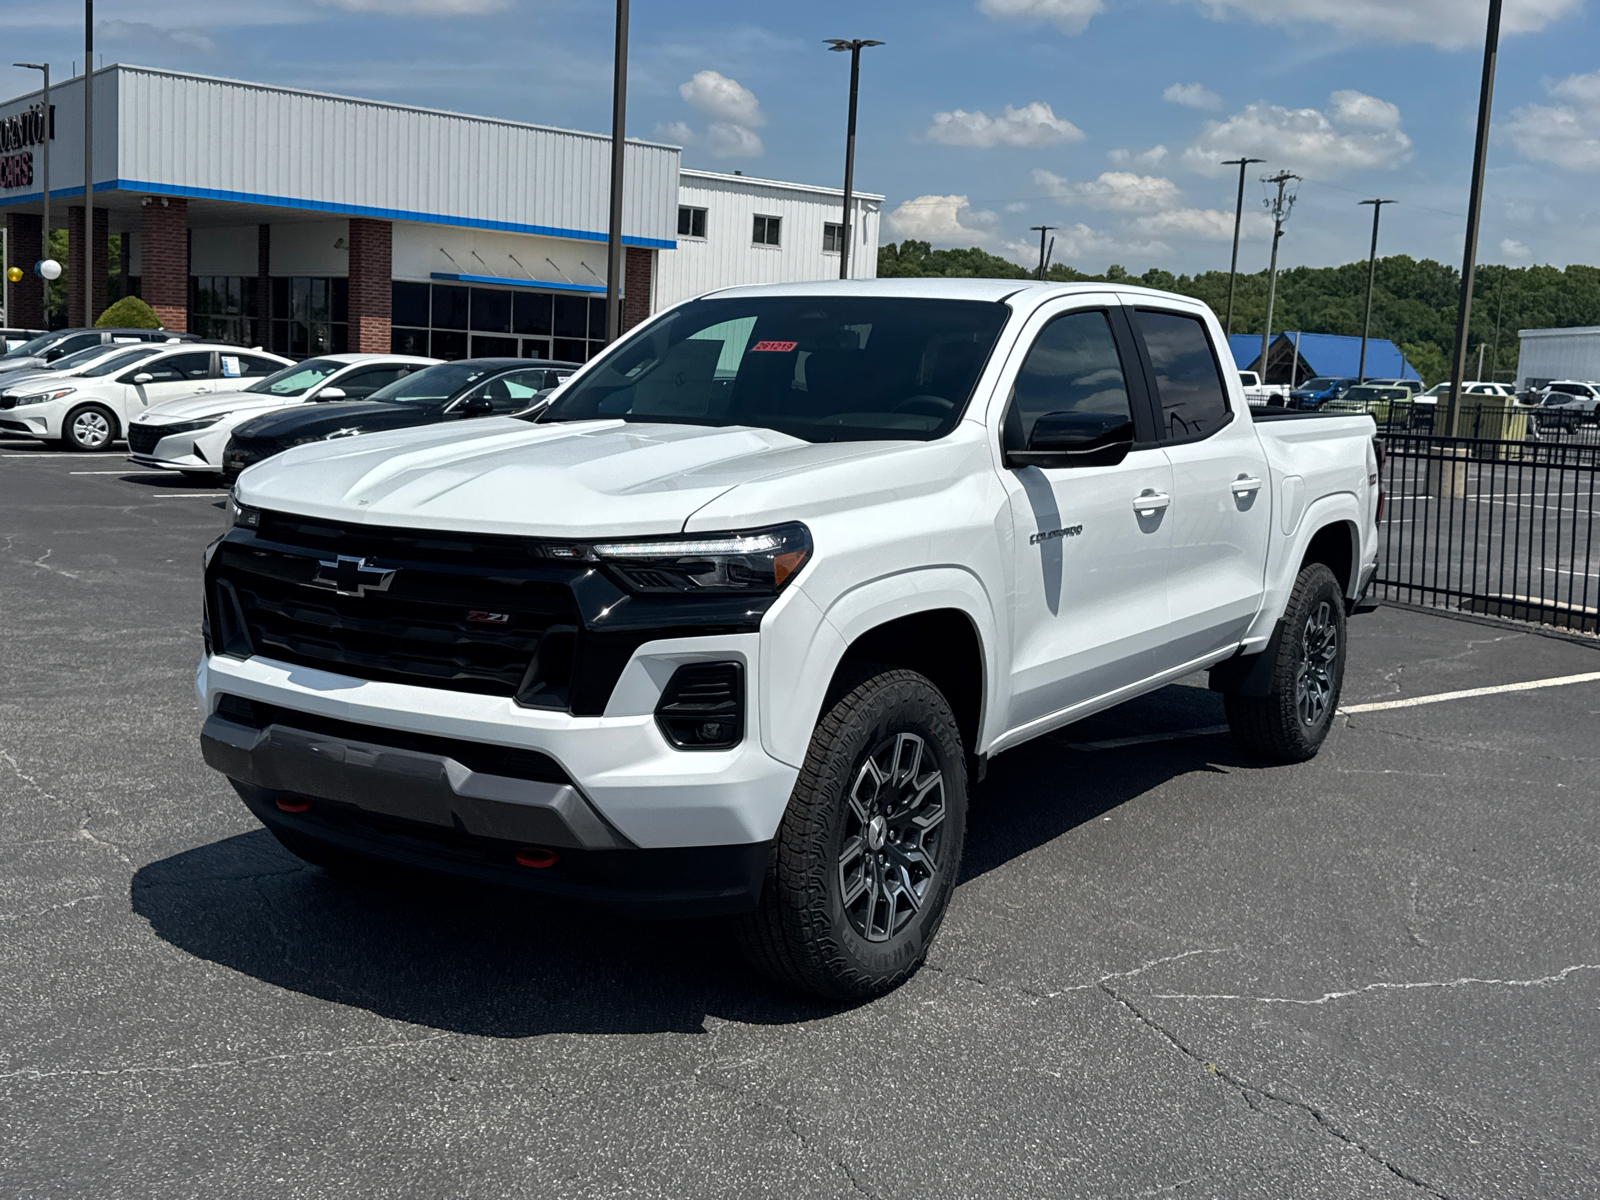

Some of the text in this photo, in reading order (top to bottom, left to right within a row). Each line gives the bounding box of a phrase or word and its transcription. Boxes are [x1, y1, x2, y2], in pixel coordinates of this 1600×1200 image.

[0, 152, 33, 188] CARS
[1030, 525, 1082, 545] COLORADO
[466, 610, 510, 624] Z71
